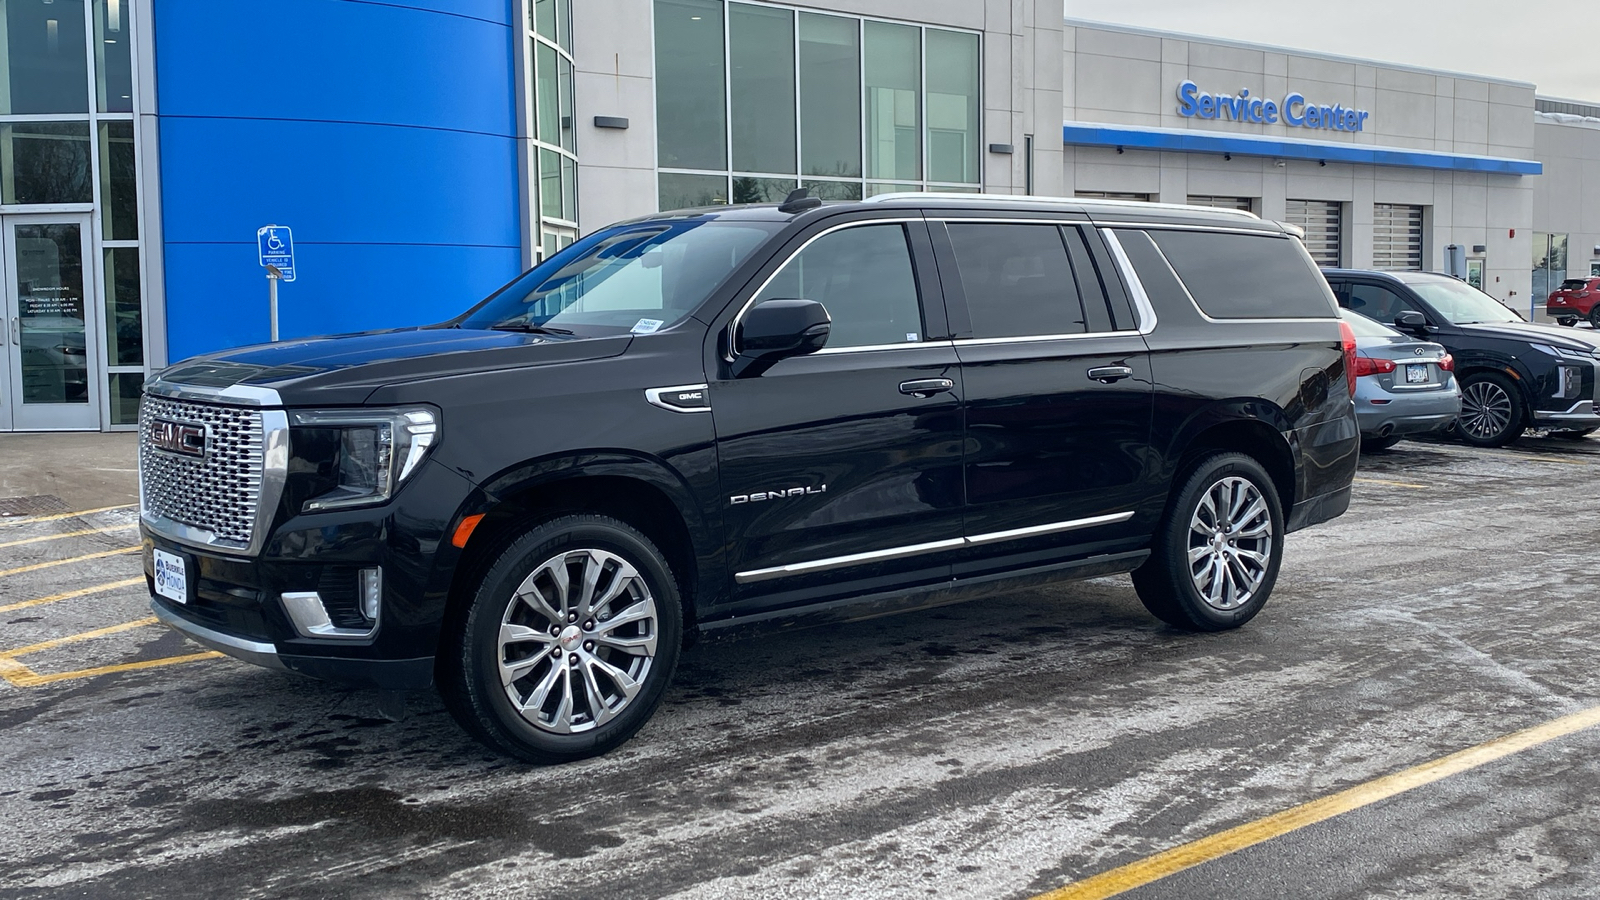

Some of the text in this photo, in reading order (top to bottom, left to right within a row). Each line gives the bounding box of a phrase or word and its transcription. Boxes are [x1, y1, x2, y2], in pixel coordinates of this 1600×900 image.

[1177, 80, 1369, 132] Service Center
[679, 392, 702, 400] GMC
[151, 422, 204, 456] GMC
[730, 484, 827, 505] DENALI
[166, 570, 185, 590] HONDA
[561, 633, 582, 643] GMC
